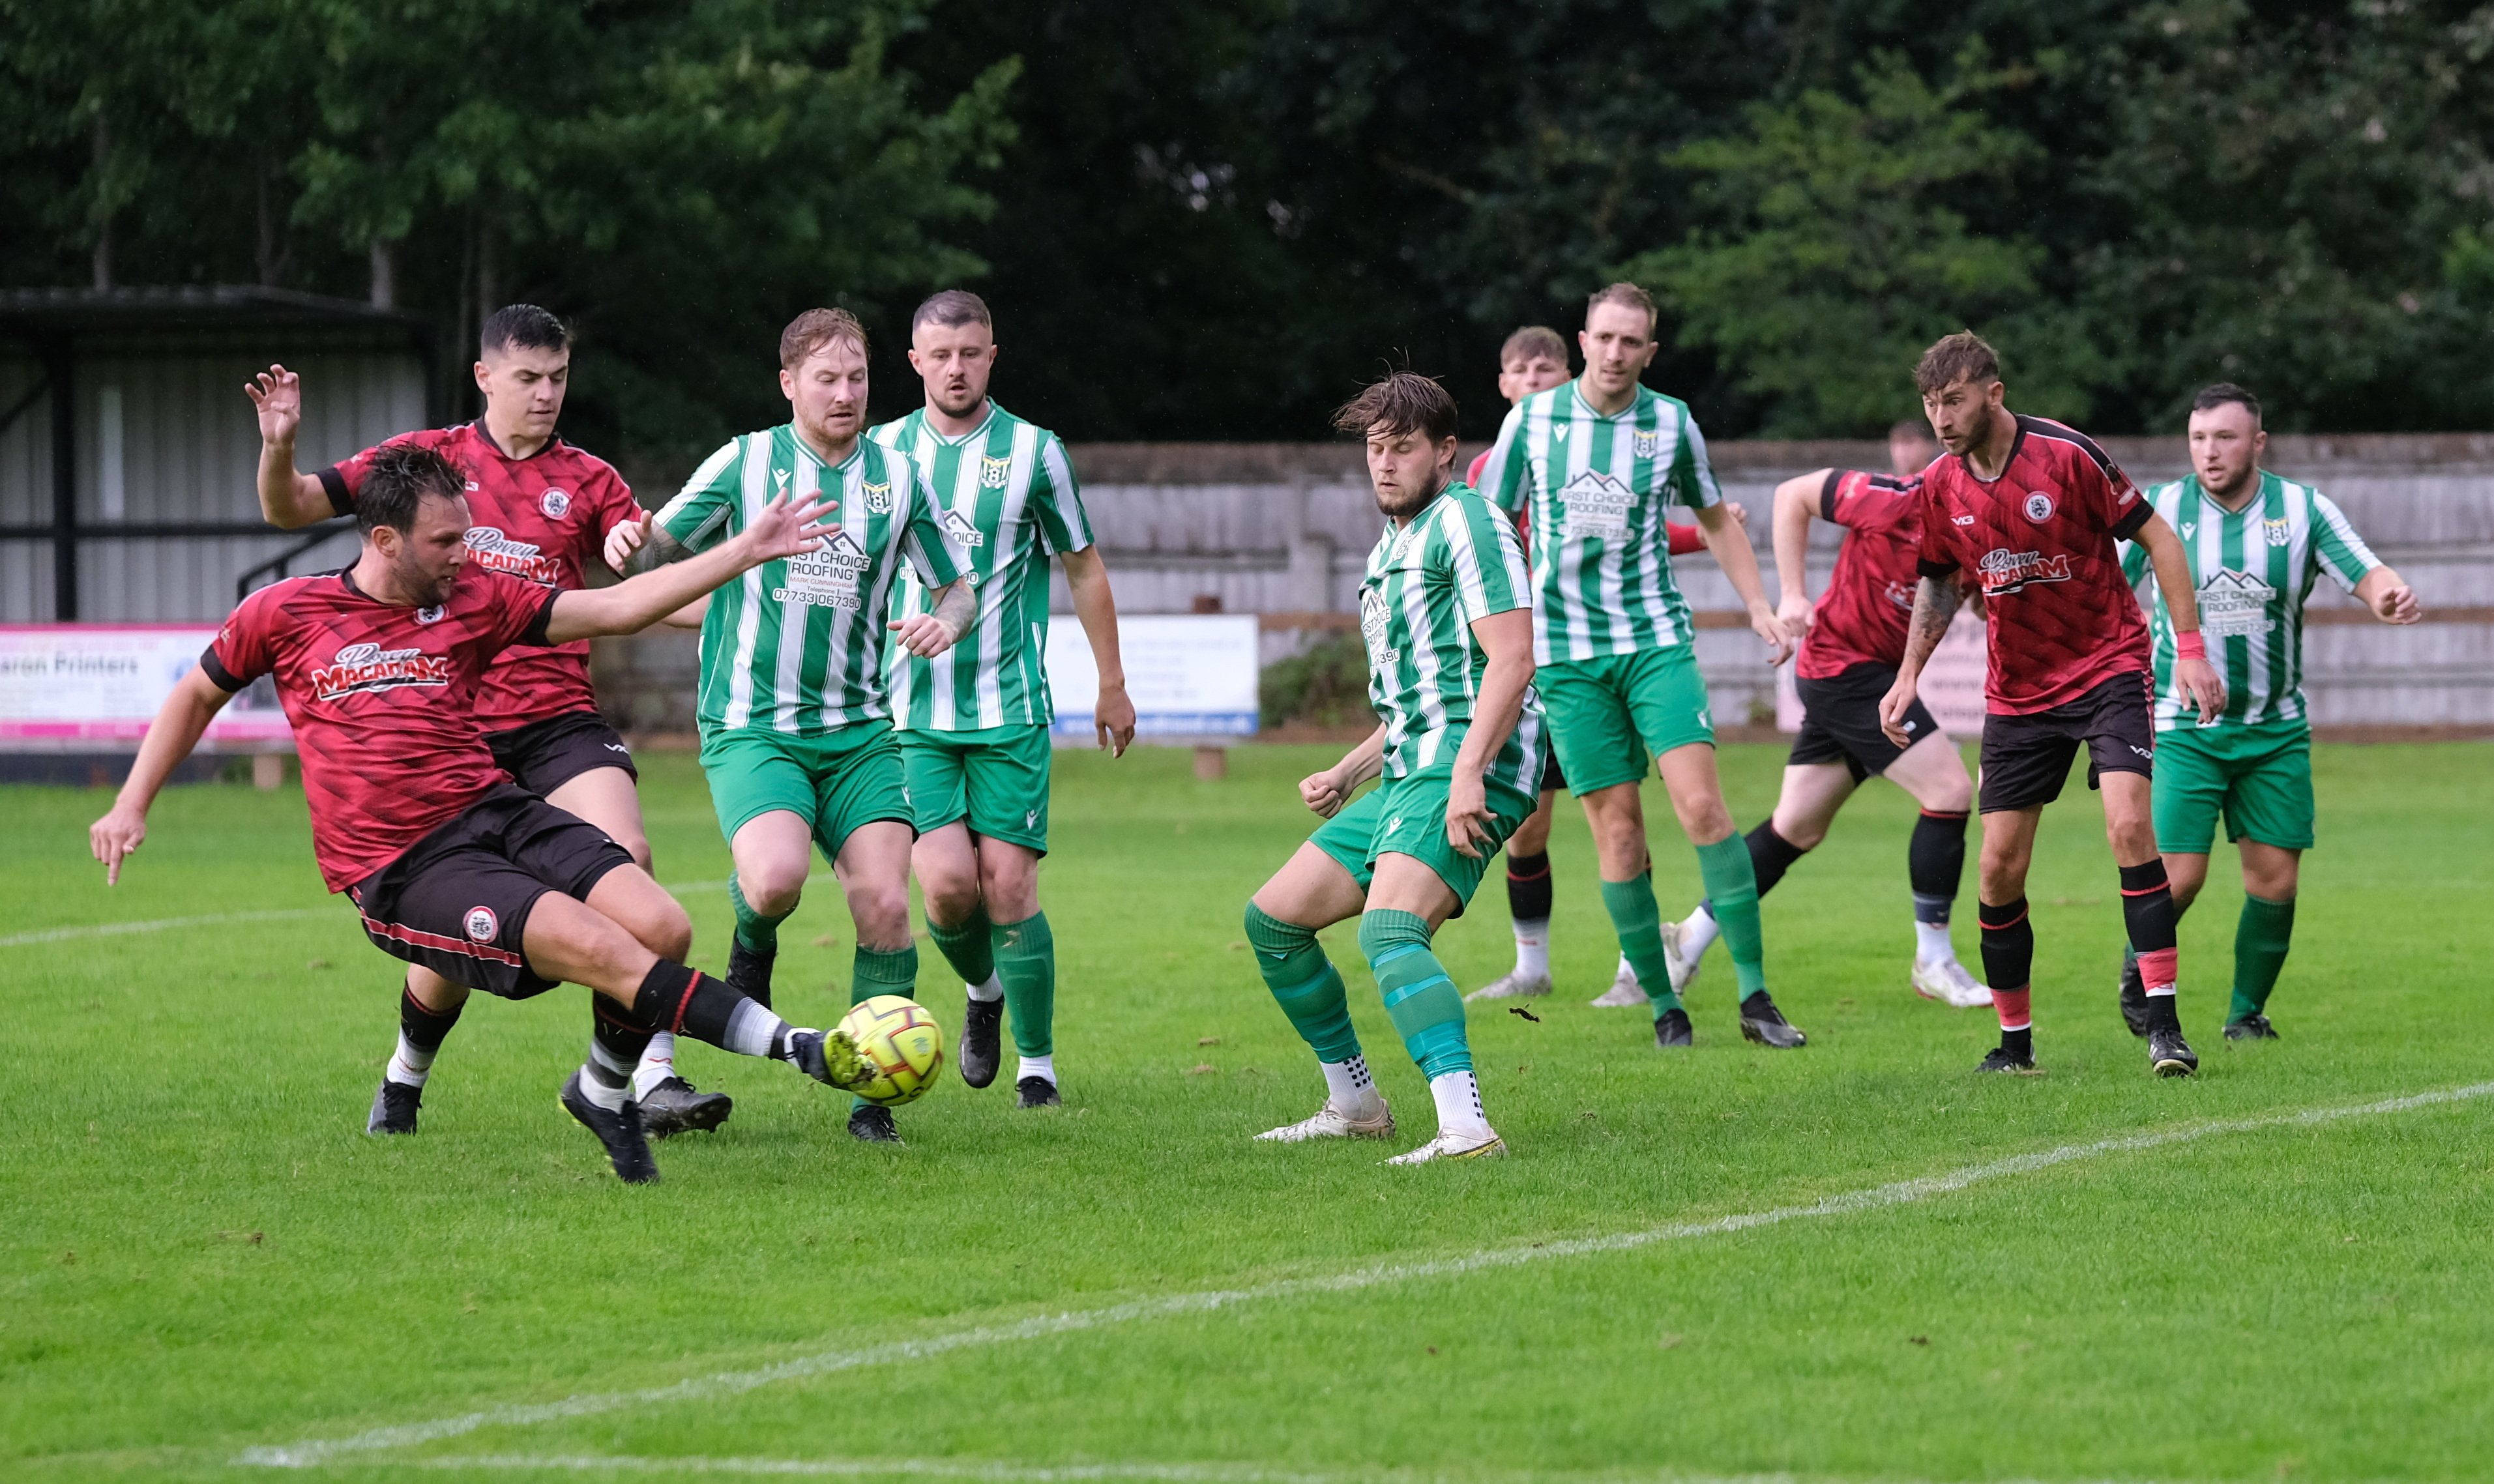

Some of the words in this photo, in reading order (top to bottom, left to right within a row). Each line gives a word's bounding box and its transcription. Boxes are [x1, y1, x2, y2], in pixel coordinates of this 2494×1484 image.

[1594, 493, 1638, 505] CHOICE
[1569, 502, 1622, 515] ROOFING
[952, 531, 982, 545] OICE
[465, 549, 561, 583] ACADAM
[820, 551, 871, 570] CHOICE
[789, 575, 810, 584] MARK
[791, 562, 854, 581] ROOFING
[807, 585, 836, 594] Telephone
[773, 589, 815, 604] 07733
[818, 594, 861, 609] 067390
[54, 652, 139, 675] Printers
[1379, 649, 1400, 664] 390
[314, 658, 448, 695] MACADAM
